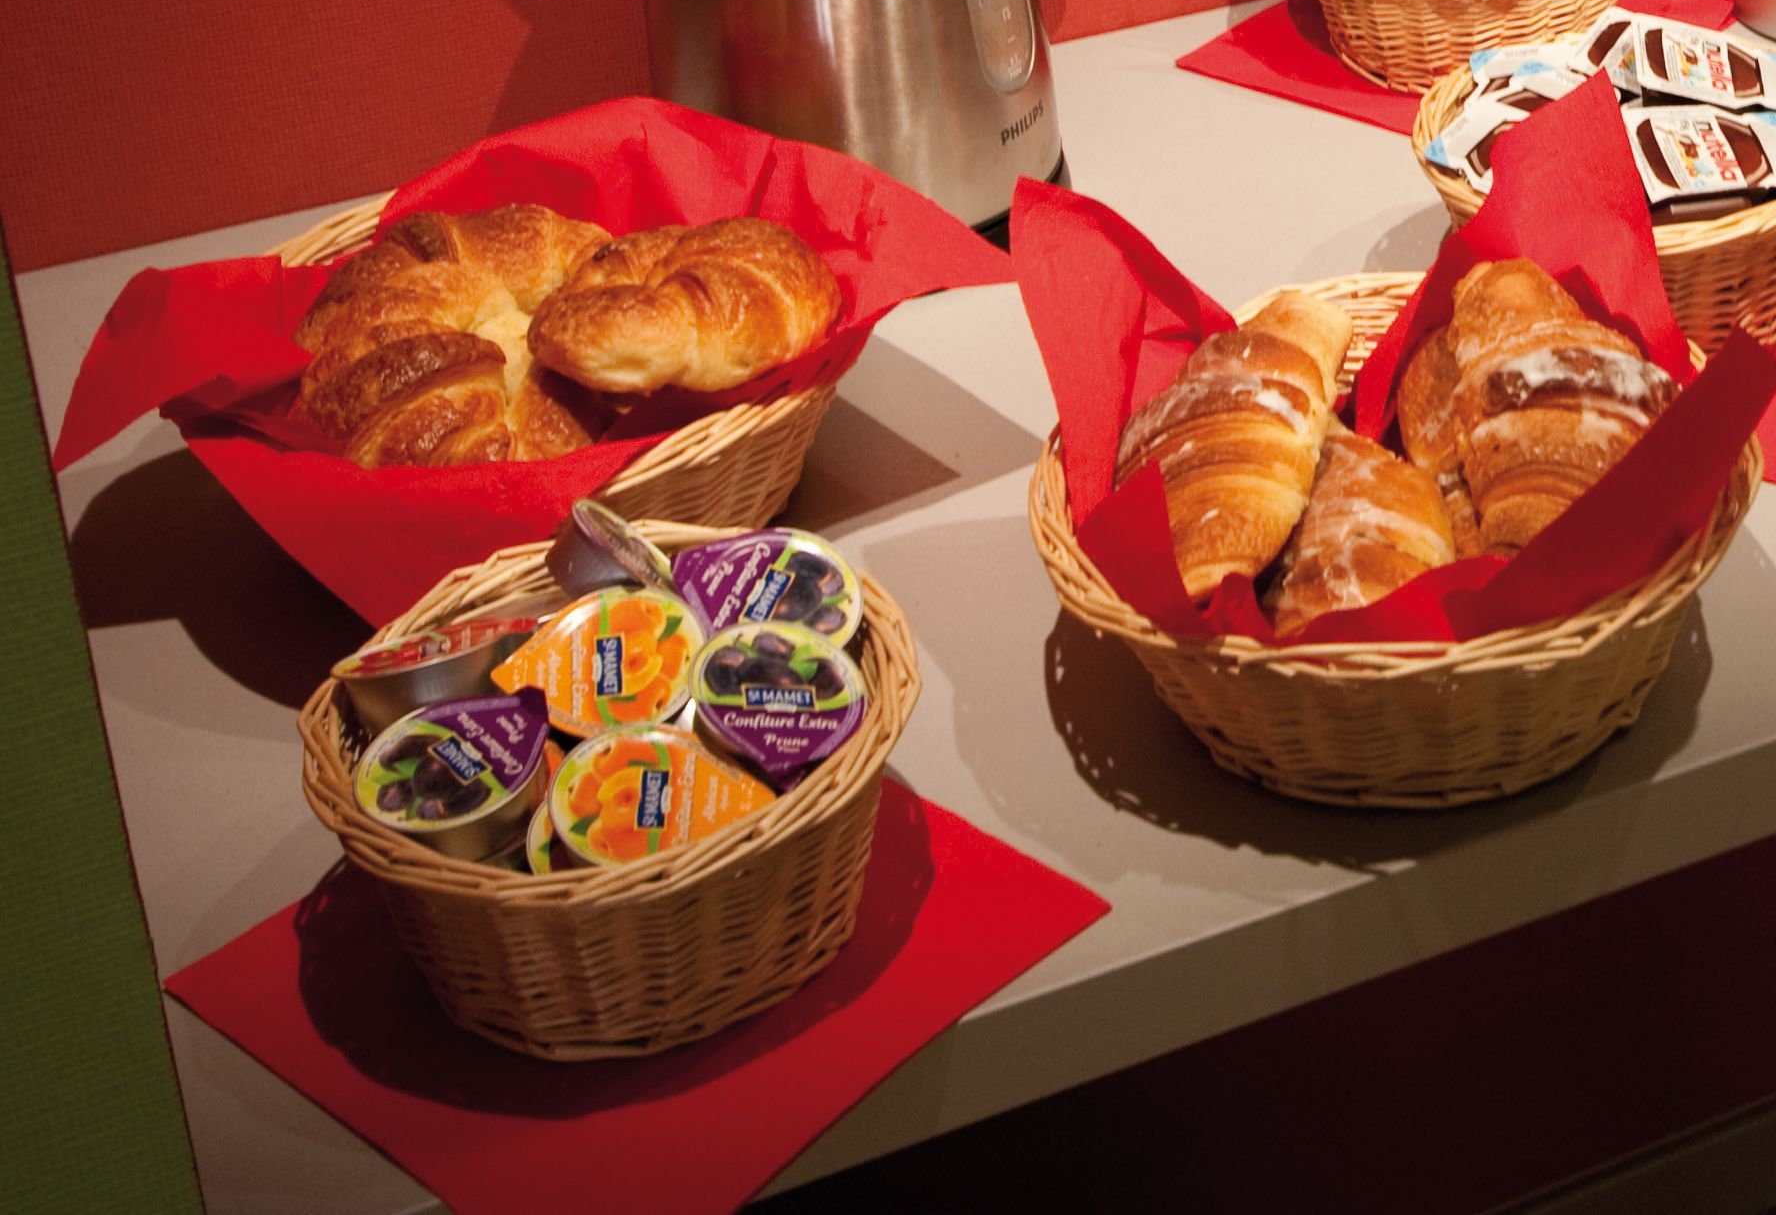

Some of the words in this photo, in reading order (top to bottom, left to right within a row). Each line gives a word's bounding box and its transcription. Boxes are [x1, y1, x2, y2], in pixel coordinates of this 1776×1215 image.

[1700, 40, 1733, 92] nutella
[1000, 99, 1044, 146] PHILIPS
[1693, 119, 1740, 182] nutella
[762, 688, 811, 707] MAMET
[723, 712, 796, 731] Confiture
[798, 712, 838, 731] Extra
[763, 733, 810, 748] Prune
